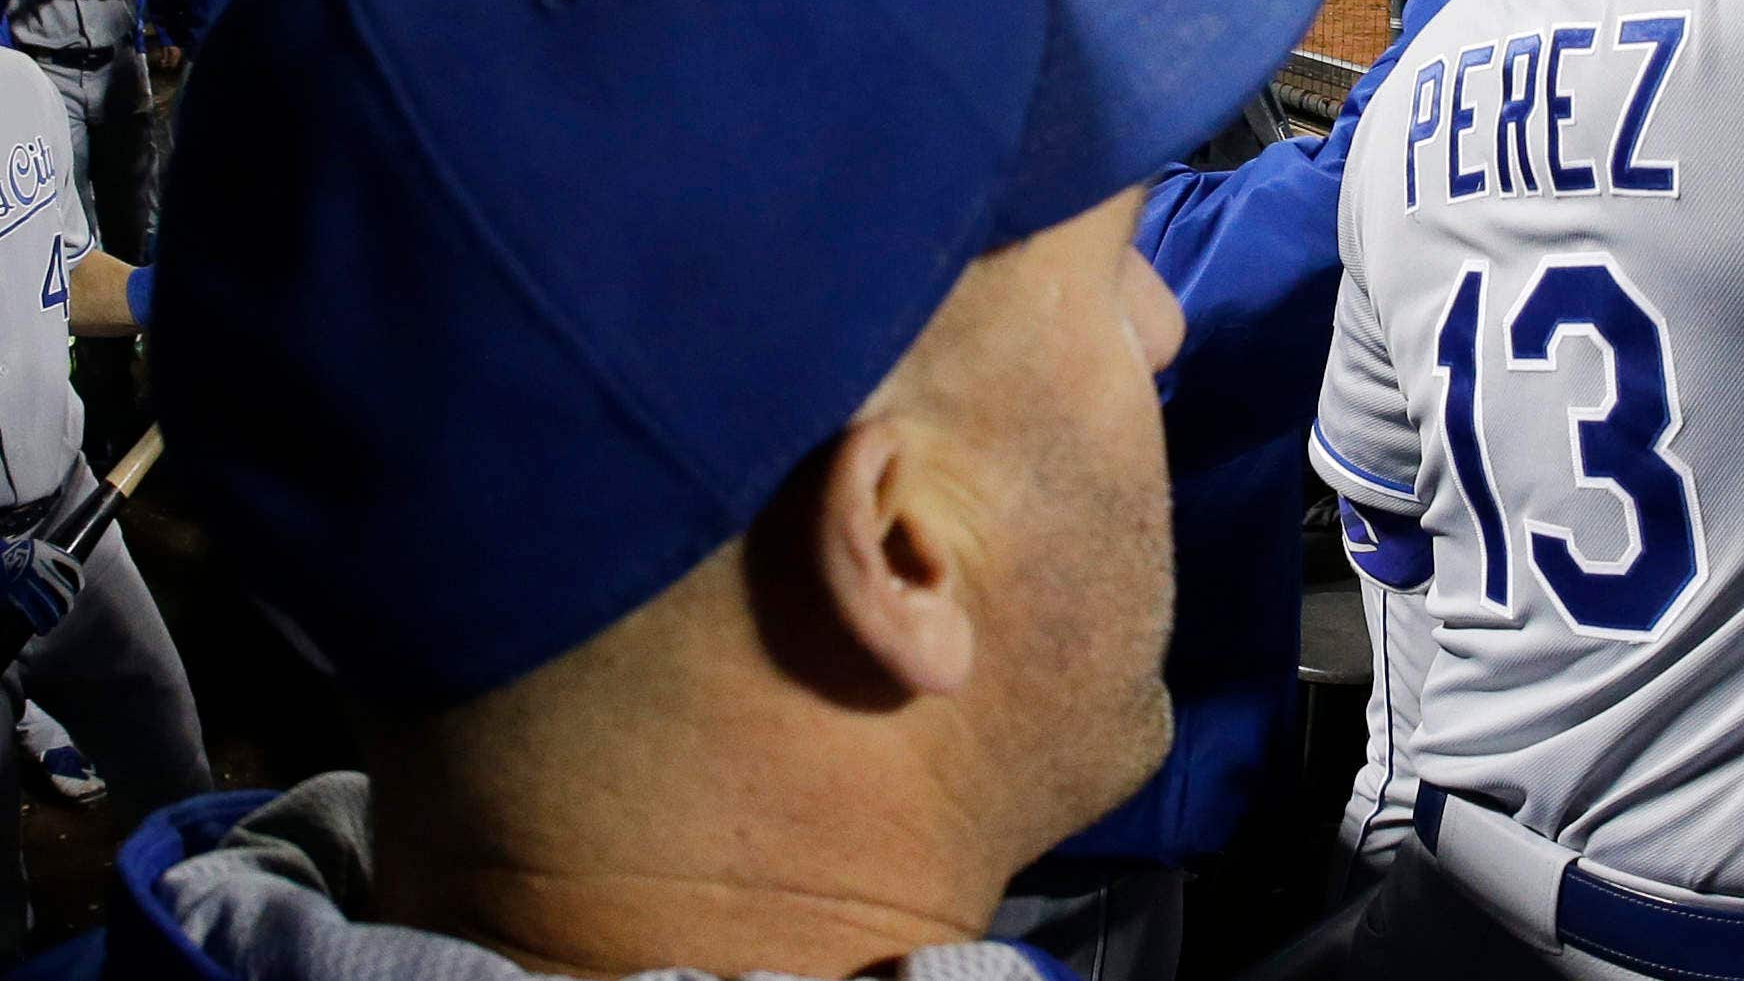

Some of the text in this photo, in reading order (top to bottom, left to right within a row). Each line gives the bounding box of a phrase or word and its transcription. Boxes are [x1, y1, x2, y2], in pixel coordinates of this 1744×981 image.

[9, 135, 56, 206] Cit
[1406, 9, 1692, 215] PEREZ
[1435, 251, 1710, 644] 13
